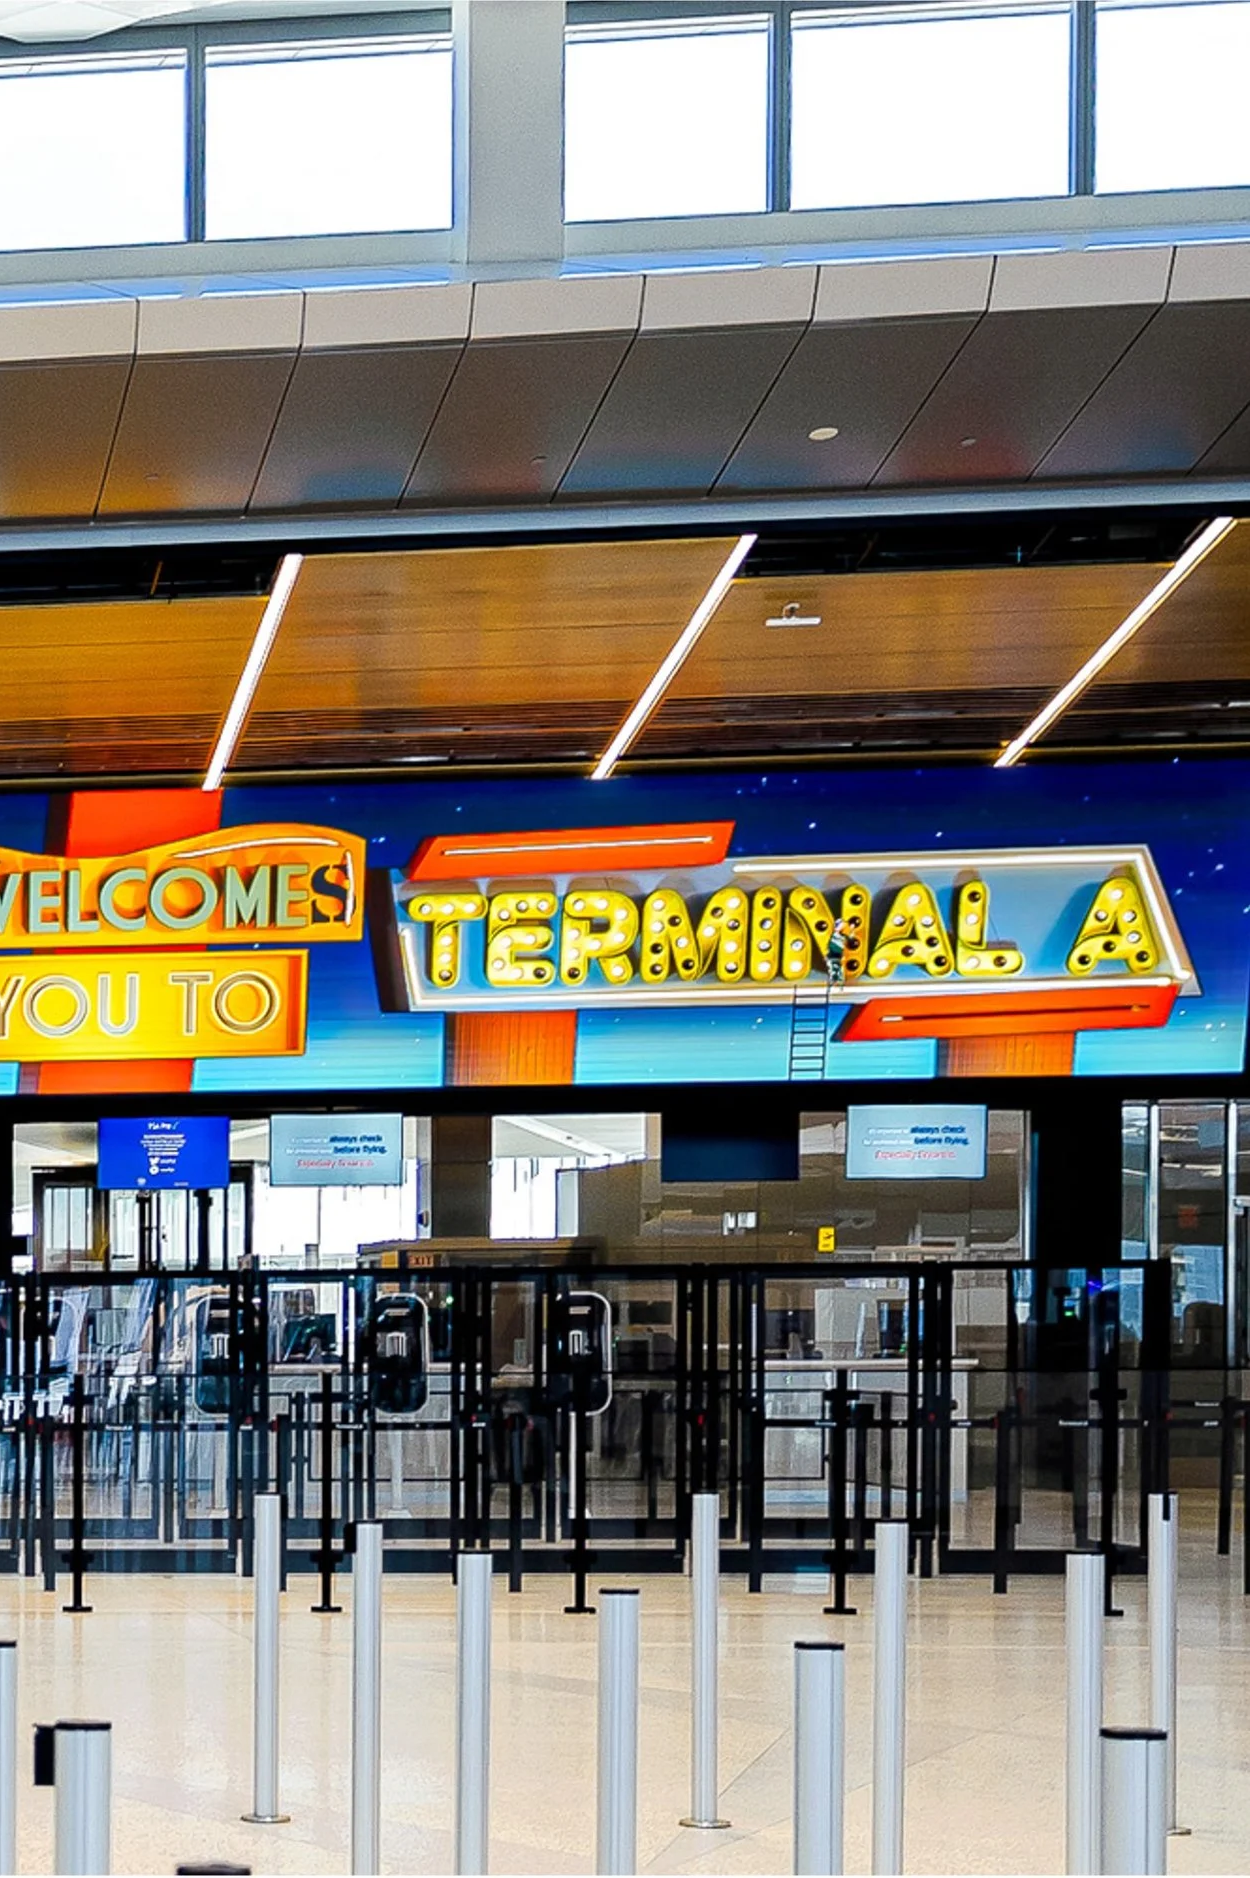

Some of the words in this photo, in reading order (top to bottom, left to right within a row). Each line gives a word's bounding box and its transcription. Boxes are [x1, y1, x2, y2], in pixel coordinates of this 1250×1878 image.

[407, 880, 1025, 988] TERMINAL
[1066, 876, 1154, 977] A
[170, 971, 280, 1036] TO
[333, 1145, 361, 1154] before
[914, 1136, 943, 1145] before
